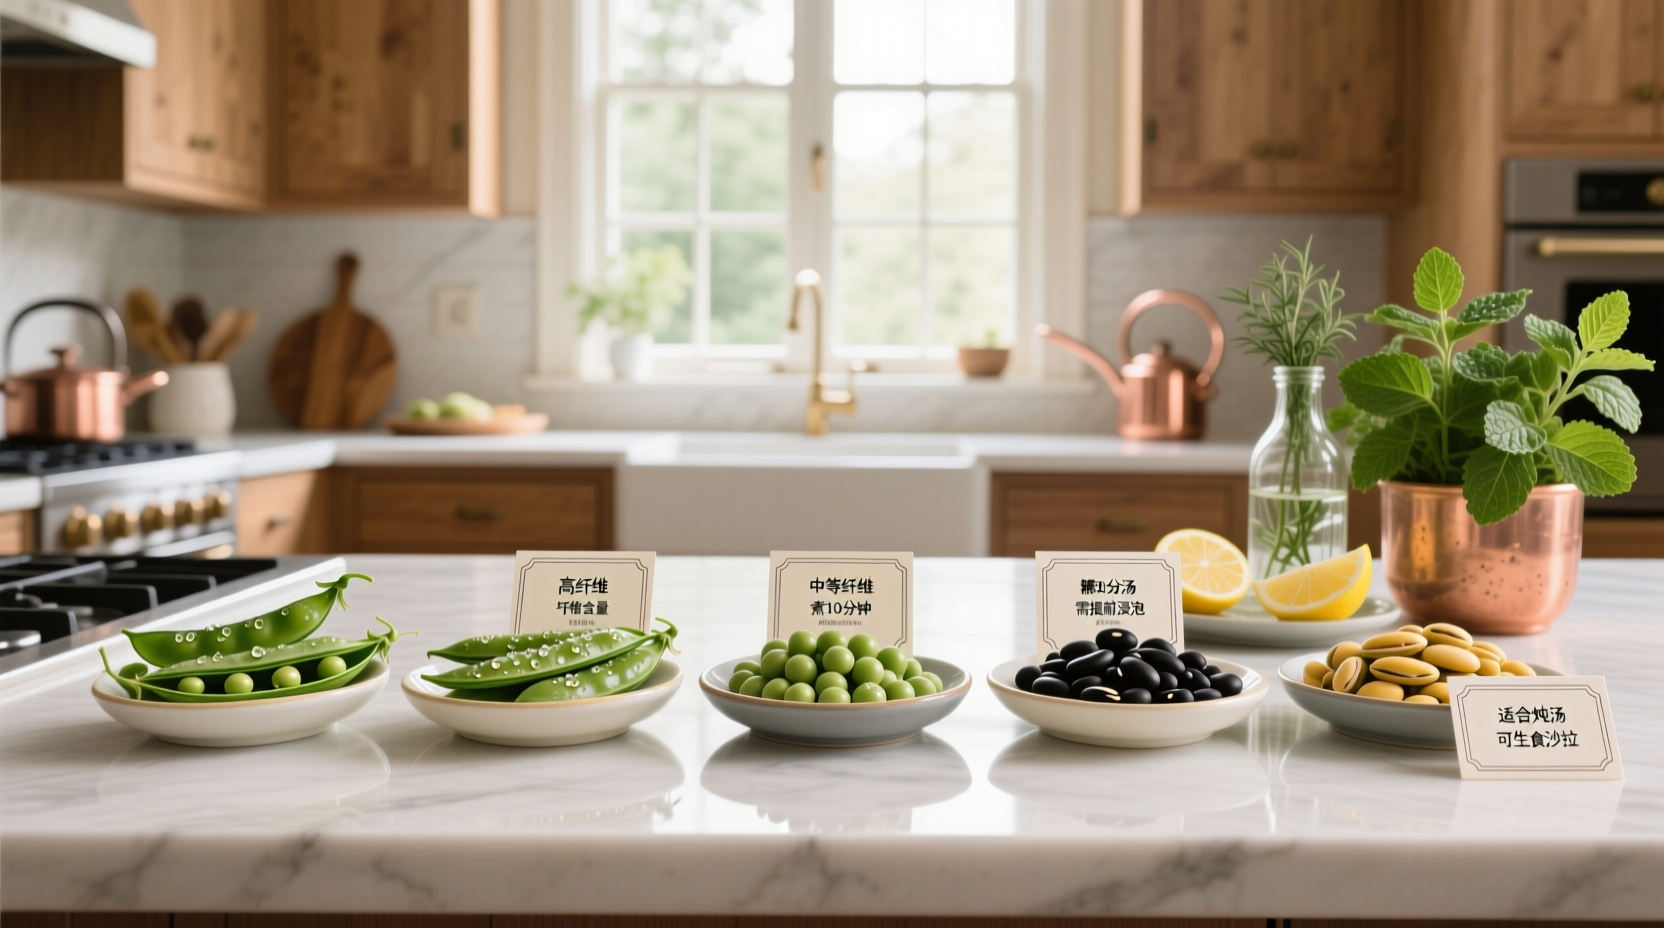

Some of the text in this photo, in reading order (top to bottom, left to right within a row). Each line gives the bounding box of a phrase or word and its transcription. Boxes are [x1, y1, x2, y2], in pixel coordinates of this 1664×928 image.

[559, 576, 608, 595] 高纤维
[810, 576, 874, 595] 中等纤维
[810, 600, 871, 616] 煮10分钟
[1498, 705, 1566, 723] 适合炖汤
[1497, 730, 1579, 748] 可生食沙拉
